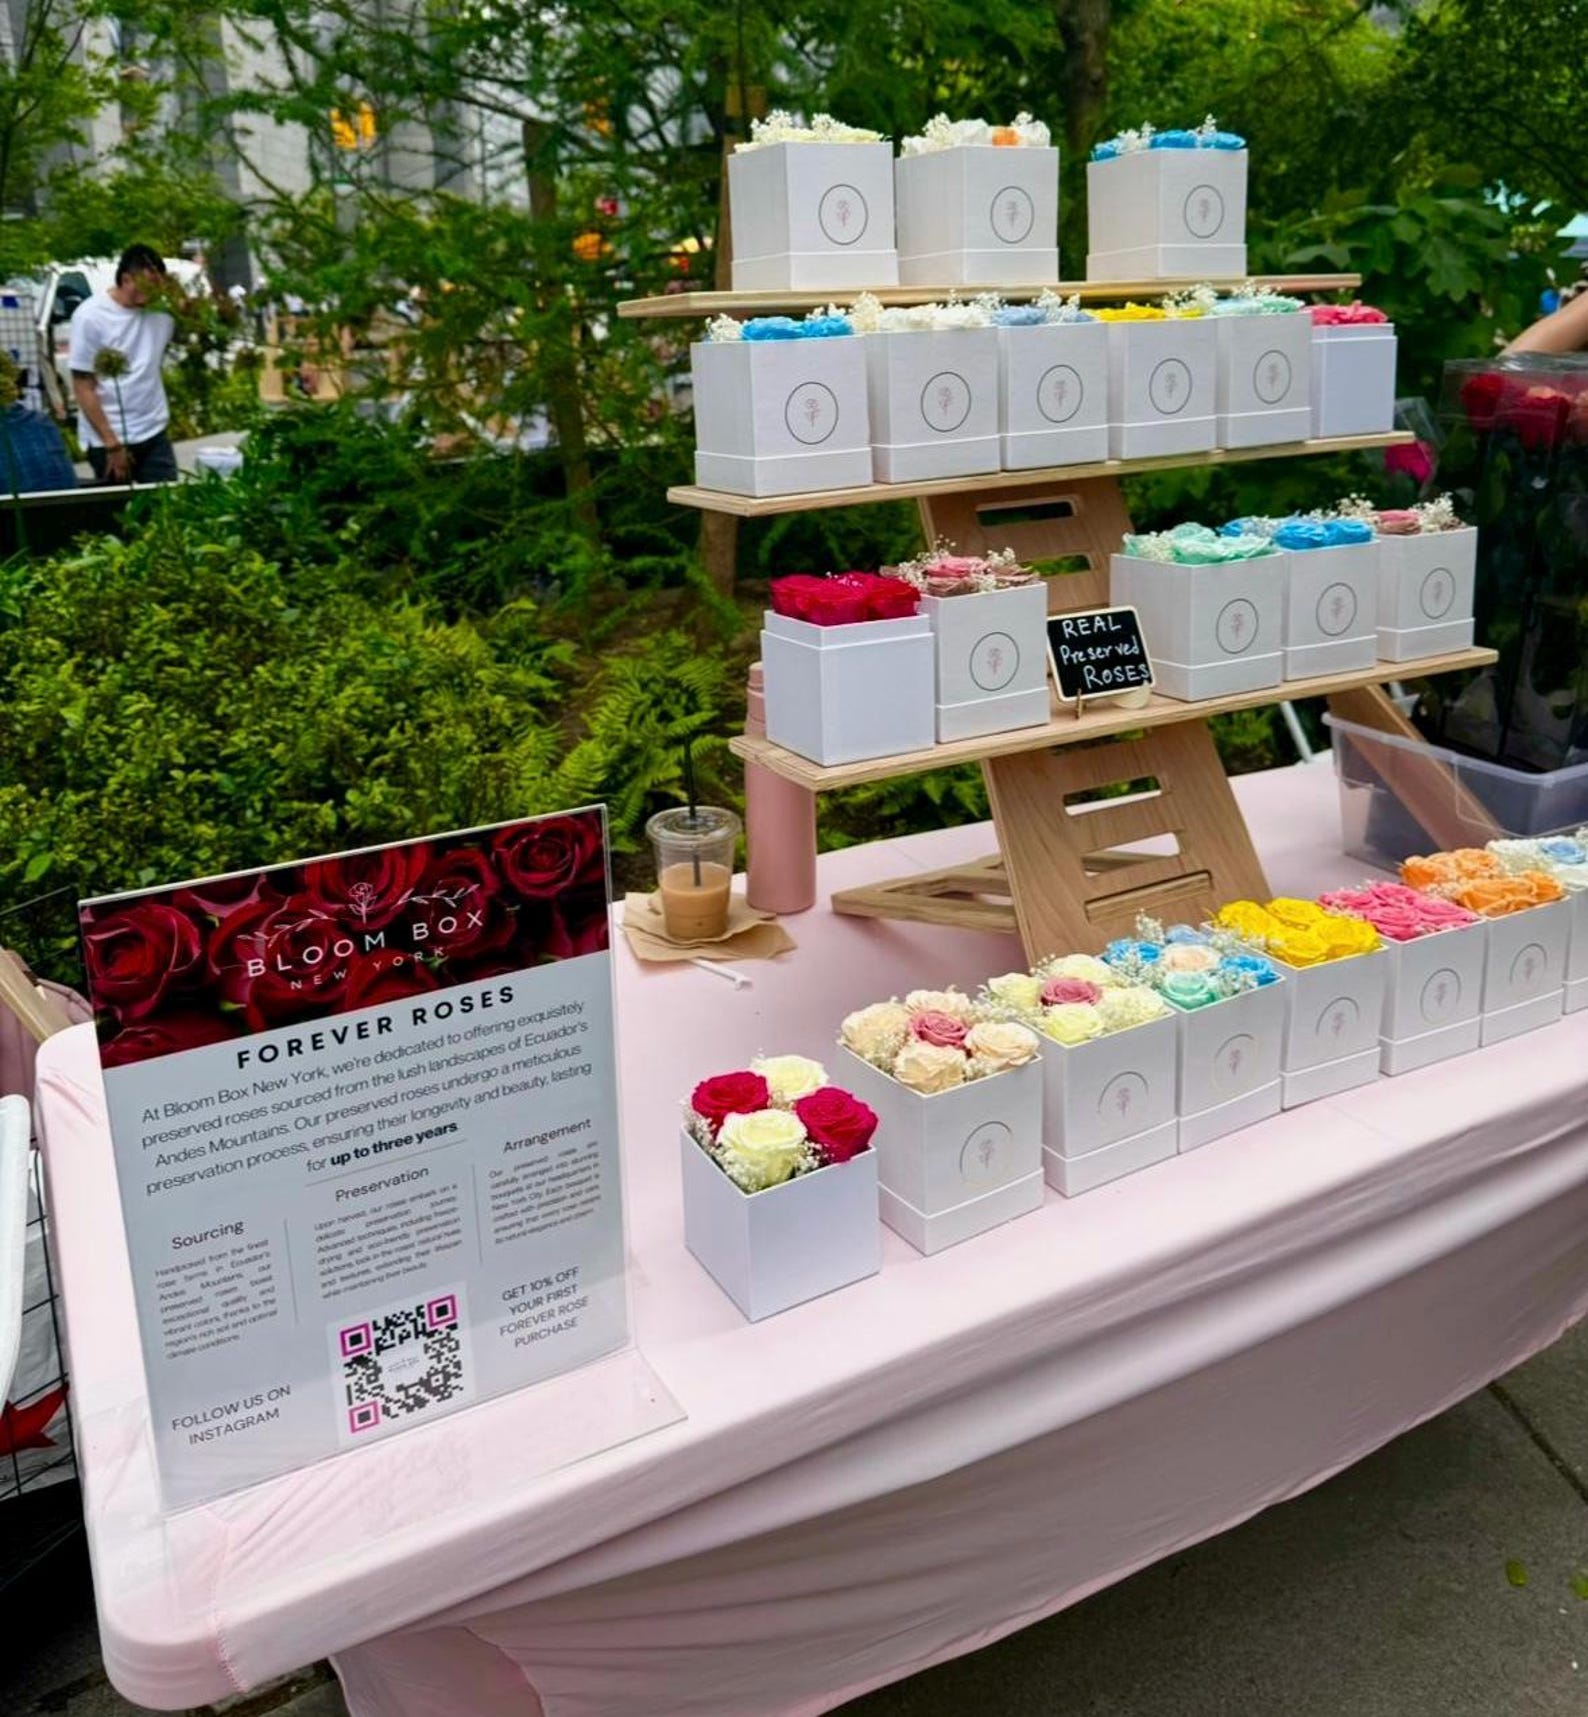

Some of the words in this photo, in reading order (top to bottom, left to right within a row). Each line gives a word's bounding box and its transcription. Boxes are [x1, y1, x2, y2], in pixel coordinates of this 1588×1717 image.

[1062, 615, 1121, 638] REAL
[1060, 635, 1140, 665] Preserved
[1083, 663, 1149, 689] ROSES
[245, 930, 387, 978] BLOOM
[411, 909, 485, 941] BOX
[289, 967, 349, 991] NEW
[371, 945, 446, 972] YORK
[237, 1016, 392, 1068] FOREVER
[412, 986, 513, 1025] ROSES
[142, 1108, 160, 1122] At
[163, 1096, 215, 1117] Bloom
[217, 1087, 249, 1103] Box
[252, 1078, 288, 1094] New
[331, 1056, 372, 1074] we're
[373, 1035, 445, 1063] dedicated
[446, 1033, 462, 1044] to
[463, 1019, 516, 1040] offering
[517, 1001, 584, 1026] exquisitely
[142, 1115, 223, 1149] preserved
[224, 1106, 269, 1125] roses
[271, 1087, 332, 1113] sourced
[334, 1079, 369, 1096] from
[371, 1072, 396, 1087] the
[397, 1064, 427, 1080] lush
[428, 1044, 506, 1071] landscapes
[507, 1036, 522, 1051] of
[524, 1022, 588, 1046] Ecuador's
[155, 1146, 207, 1167] Andes
[293, 1114, 322, 1130] Our
[325, 1092, 398, 1124] preserved
[400, 1083, 440, 1101] roses
[441, 1067, 499, 1090] undergo
[500, 1064, 511, 1074] a
[512, 1045, 582, 1070] meticulous
[146, 1159, 244, 1195] preservation
[312, 1123, 375, 1148] ensuring
[376, 1114, 407, 1130] their
[410, 1097, 471, 1120] longevity
[473, 1086, 500, 1103] and
[551, 1063, 592, 1081] lasting
[503, 1119, 591, 1152] Arrangement
[306, 1158, 327, 1172] for
[330, 1152, 352, 1165] up
[353, 1147, 371, 1158] to
[371, 1135, 414, 1153] three
[335, 1168, 429, 1201] Preservation
[172, 1221, 244, 1249] Sourcing
[501, 1284, 527, 1300] GET
[529, 1277, 554, 1291] 10%
[554, 1266, 579, 1282] OFF
[508, 1296, 544, 1314] YOUR
[546, 1283, 578, 1302] FIRST
[499, 1309, 556, 1335] FOREVER
[558, 1295, 588, 1315] ROSE
[514, 1317, 578, 1347] PURCHASE
[172, 1401, 240, 1430] FOLLOW
[243, 1394, 264, 1409] US
[267, 1385, 291, 1400] ON
[189, 1408, 280, 1443] INSTAGRAM
